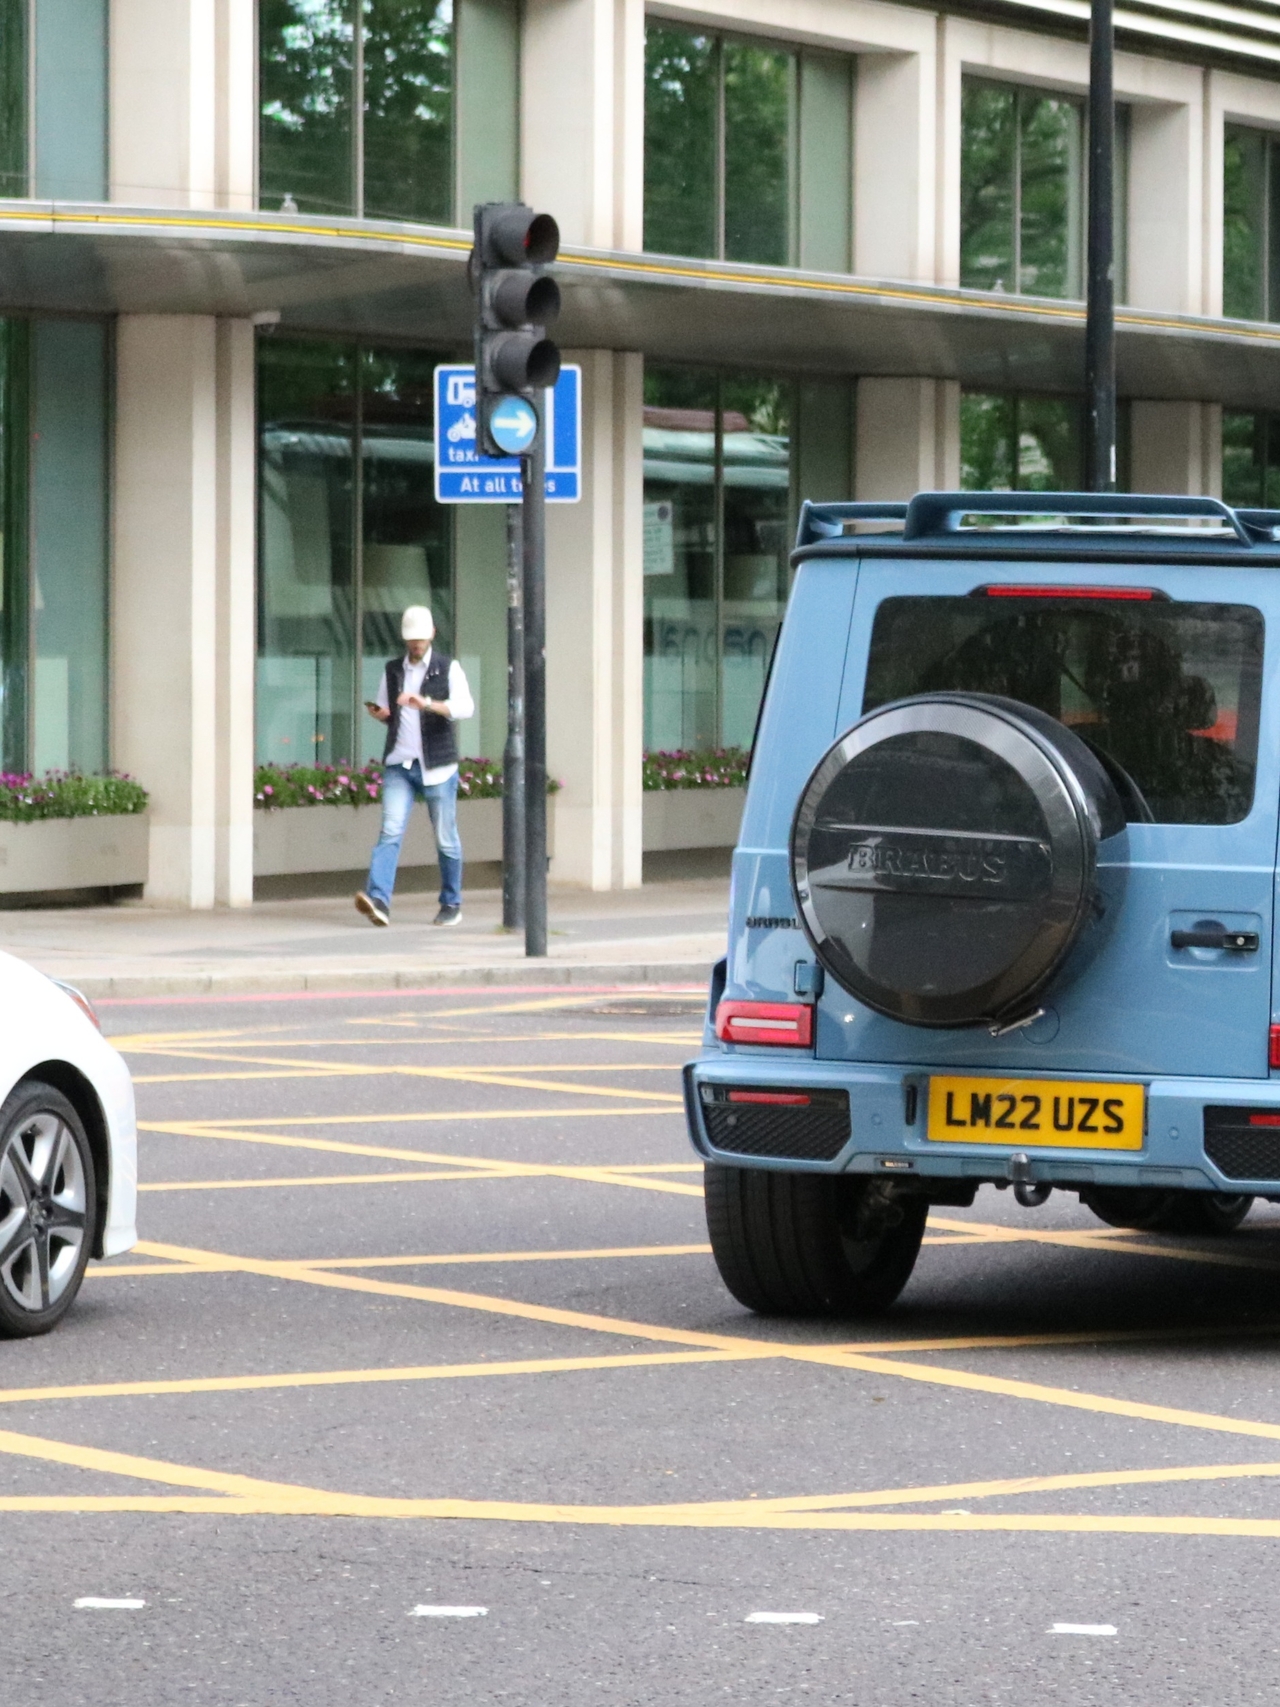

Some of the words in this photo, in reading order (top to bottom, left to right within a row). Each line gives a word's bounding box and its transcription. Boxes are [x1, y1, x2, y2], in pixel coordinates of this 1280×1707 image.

[460, 477, 480, 492] At
[485, 477, 506, 492] all
[511, 478, 556, 492] tis
[848, 844, 1007, 883] BRABUS
[945, 1091, 1041, 1131] LM22
[1053, 1097, 1125, 1134] UZS
